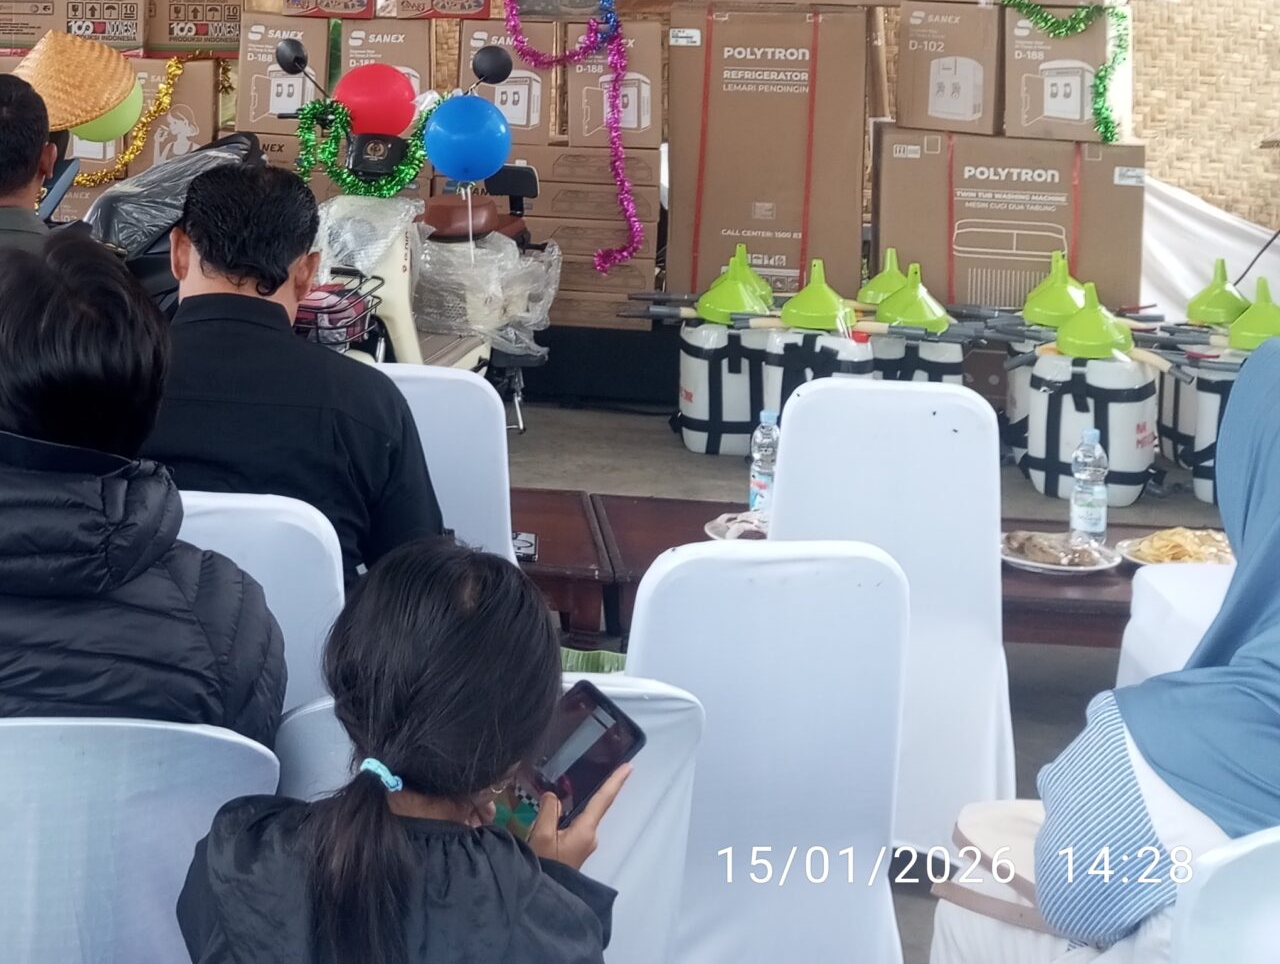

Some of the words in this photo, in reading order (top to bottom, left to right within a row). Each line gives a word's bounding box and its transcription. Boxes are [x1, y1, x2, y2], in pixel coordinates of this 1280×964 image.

[124, 5, 135, 13] 10
[227, 7, 238, 15] 10
[927, 15, 961, 25] SANEX
[267, 29, 304, 40] SANEX
[368, 34, 406, 43] SANEX
[909, 40, 945, 52] D-102
[247, 53, 273, 62] D-188
[723, 47, 810, 61] POLYTRON
[1014, 51, 1044, 60] D-188
[576, 64, 604, 73] D-188
[723, 70, 809, 81] REFRIGERATOR
[723, 83, 757, 92] LEMARI
[758, 84, 809, 93] PENDINGIN
[963, 166, 1060, 183] POLYTRON
[965, 201, 988, 209] MESIN
[990, 202, 1007, 210] CUCI
[1009, 203, 1024, 211] DUA
[1026, 204, 1056, 212] TABUNG
[721, 228, 740, 236] CALL
